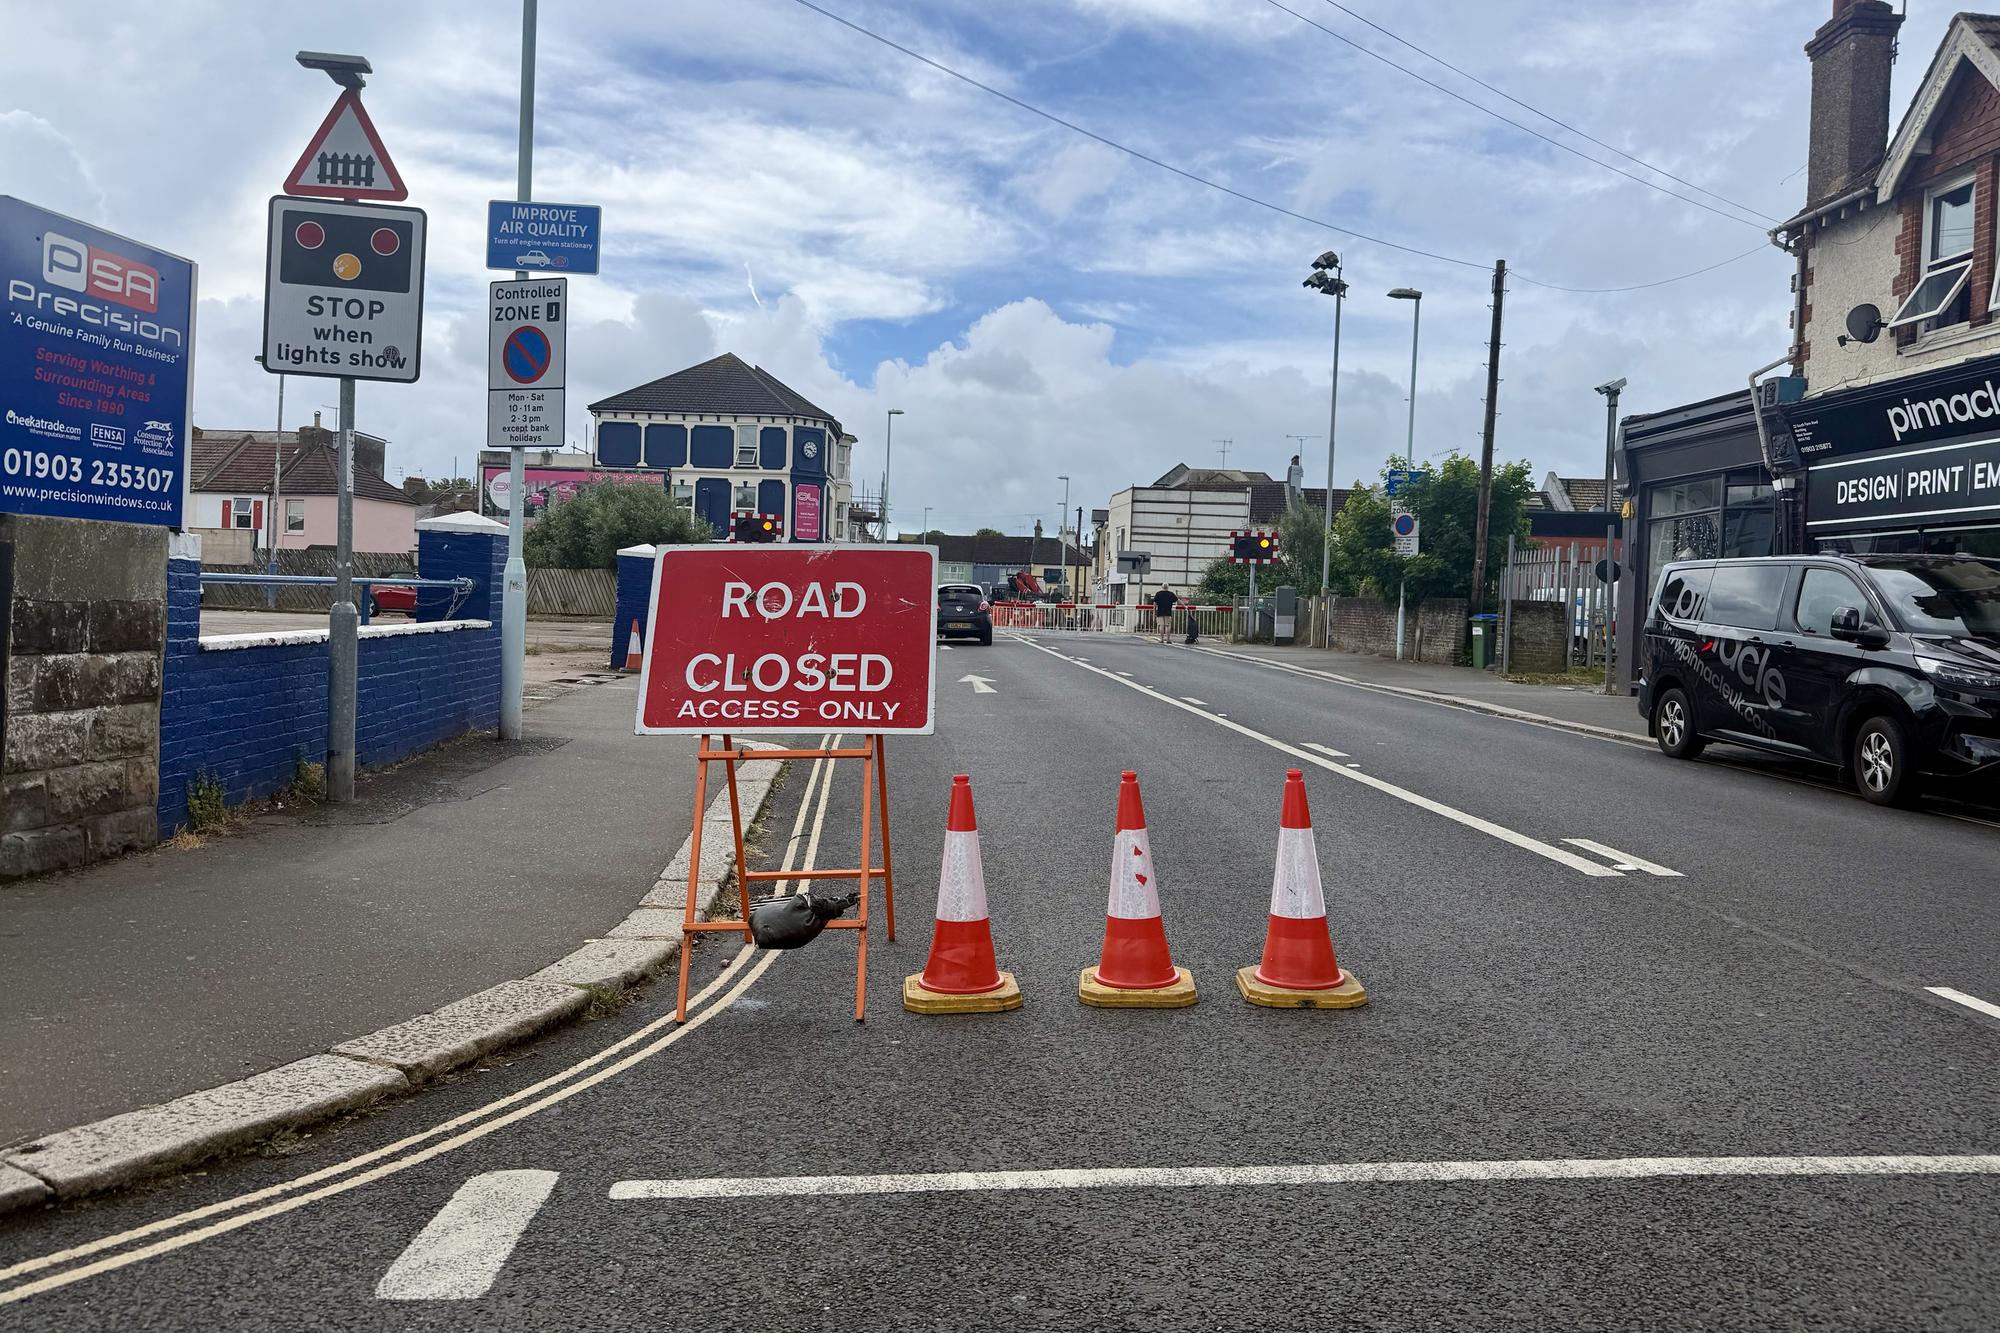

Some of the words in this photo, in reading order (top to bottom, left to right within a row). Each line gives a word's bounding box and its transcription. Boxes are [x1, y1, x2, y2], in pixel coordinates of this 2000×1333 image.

[512, 206, 577, 223] IMPROVE
[499, 220, 524, 234] AIR
[527, 222, 588, 238] QUALITY
[494, 237, 508, 245] Turn
[519, 240, 541, 248] engine
[560, 241, 593, 251] stationary
[48, 243, 155, 305] PSA
[495, 285, 561, 300] Controlled
[306, 295, 385, 320] STOP
[494, 305, 540, 322] ZONE
[26, 316, 74, 338] Genuine
[76, 329, 111, 350] Family
[113, 338, 133, 353] Run
[313, 324, 373, 344] when
[36, 347, 87, 372] Serving
[91, 360, 145, 386] Worthing
[147, 373, 156, 385] &
[277, 343, 341, 365] lights
[348, 349, 407, 370] show
[34, 367, 114, 398] Surrounding
[117, 385, 151, 402] Areas
[57, 391, 93, 410] Since
[96, 399, 125, 417] 1990
[508, 393, 525, 401] Mon
[531, 393, 545, 401] Sat
[508, 404, 518, 412] 10
[1886, 380, 2000, 441] pinnacl
[502, 425, 528, 433] except
[530, 424, 550, 432] bank
[528, 416, 541, 424] pm
[93, 427, 123, 442] FENSA
[133, 435, 163, 448] Protection
[137, 429, 166, 442] Consumer
[509, 434, 542, 443] holidays
[142, 446, 174, 457] Association
[3, 448, 83, 483] 01903
[91, 460, 174, 493] 235307
[1837, 474, 1898, 504] DESIGN
[1907, 465, 1964, 497] PRINT
[2, 484, 173, 512] www.precisionwindows.co.uk
[721, 581, 867, 619] ROAD
[685, 652, 893, 693] CLOSED
[676, 700, 800, 719] ACCESS
[819, 700, 901, 721] ONLY
